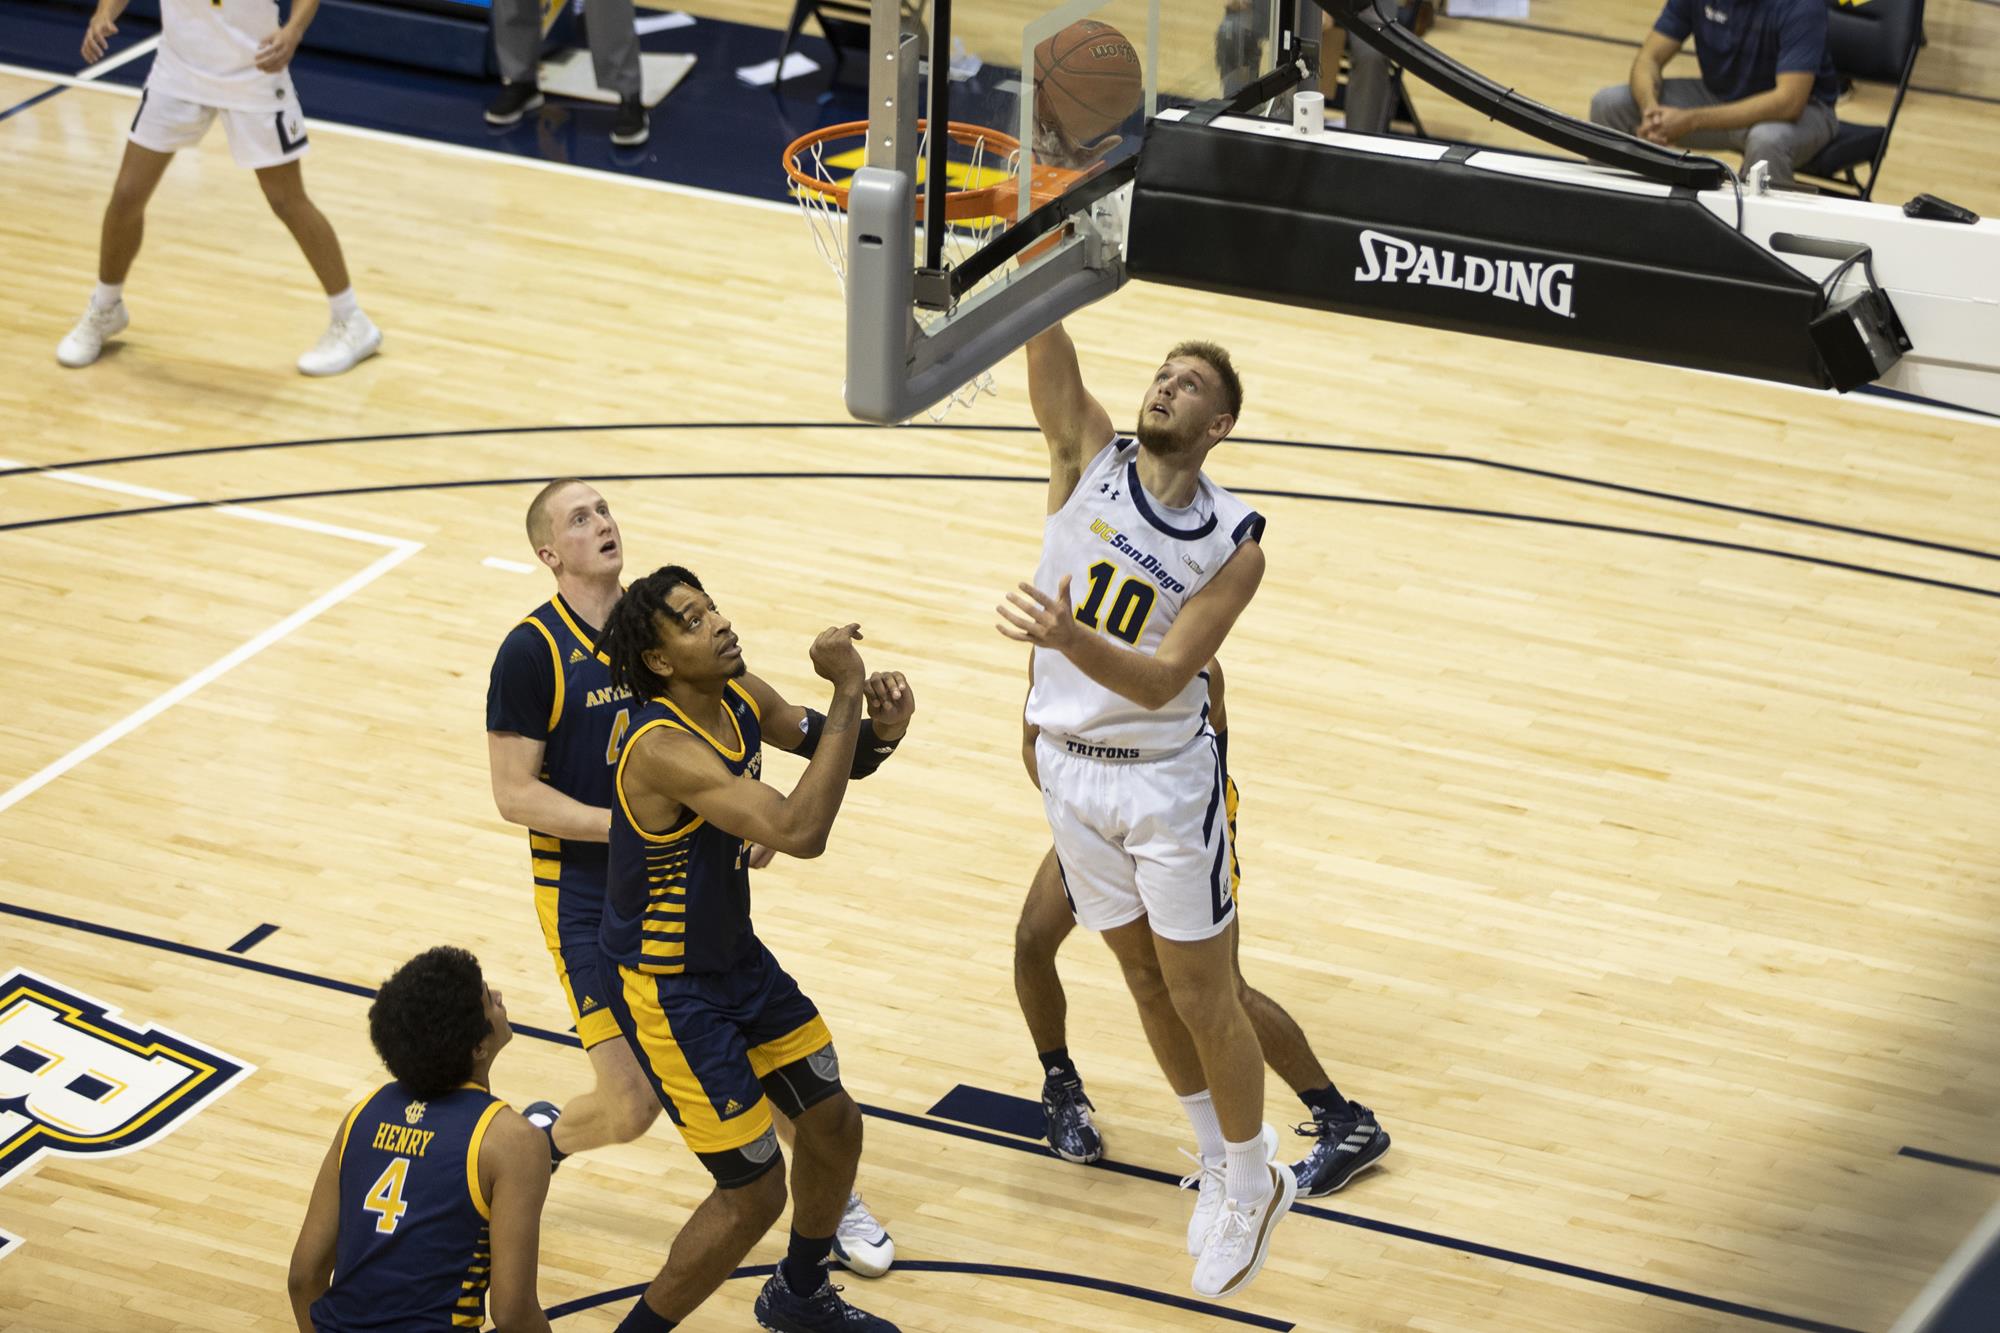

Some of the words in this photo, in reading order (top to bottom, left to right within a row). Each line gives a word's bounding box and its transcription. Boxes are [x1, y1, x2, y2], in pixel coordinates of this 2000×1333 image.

[1354, 229, 1576, 317] SPALDING
[1073, 560, 1158, 647] 10
[1065, 739, 1140, 759] TRITONS
[372, 1121, 435, 1157] HENRY
[363, 1156, 411, 1234] 4
